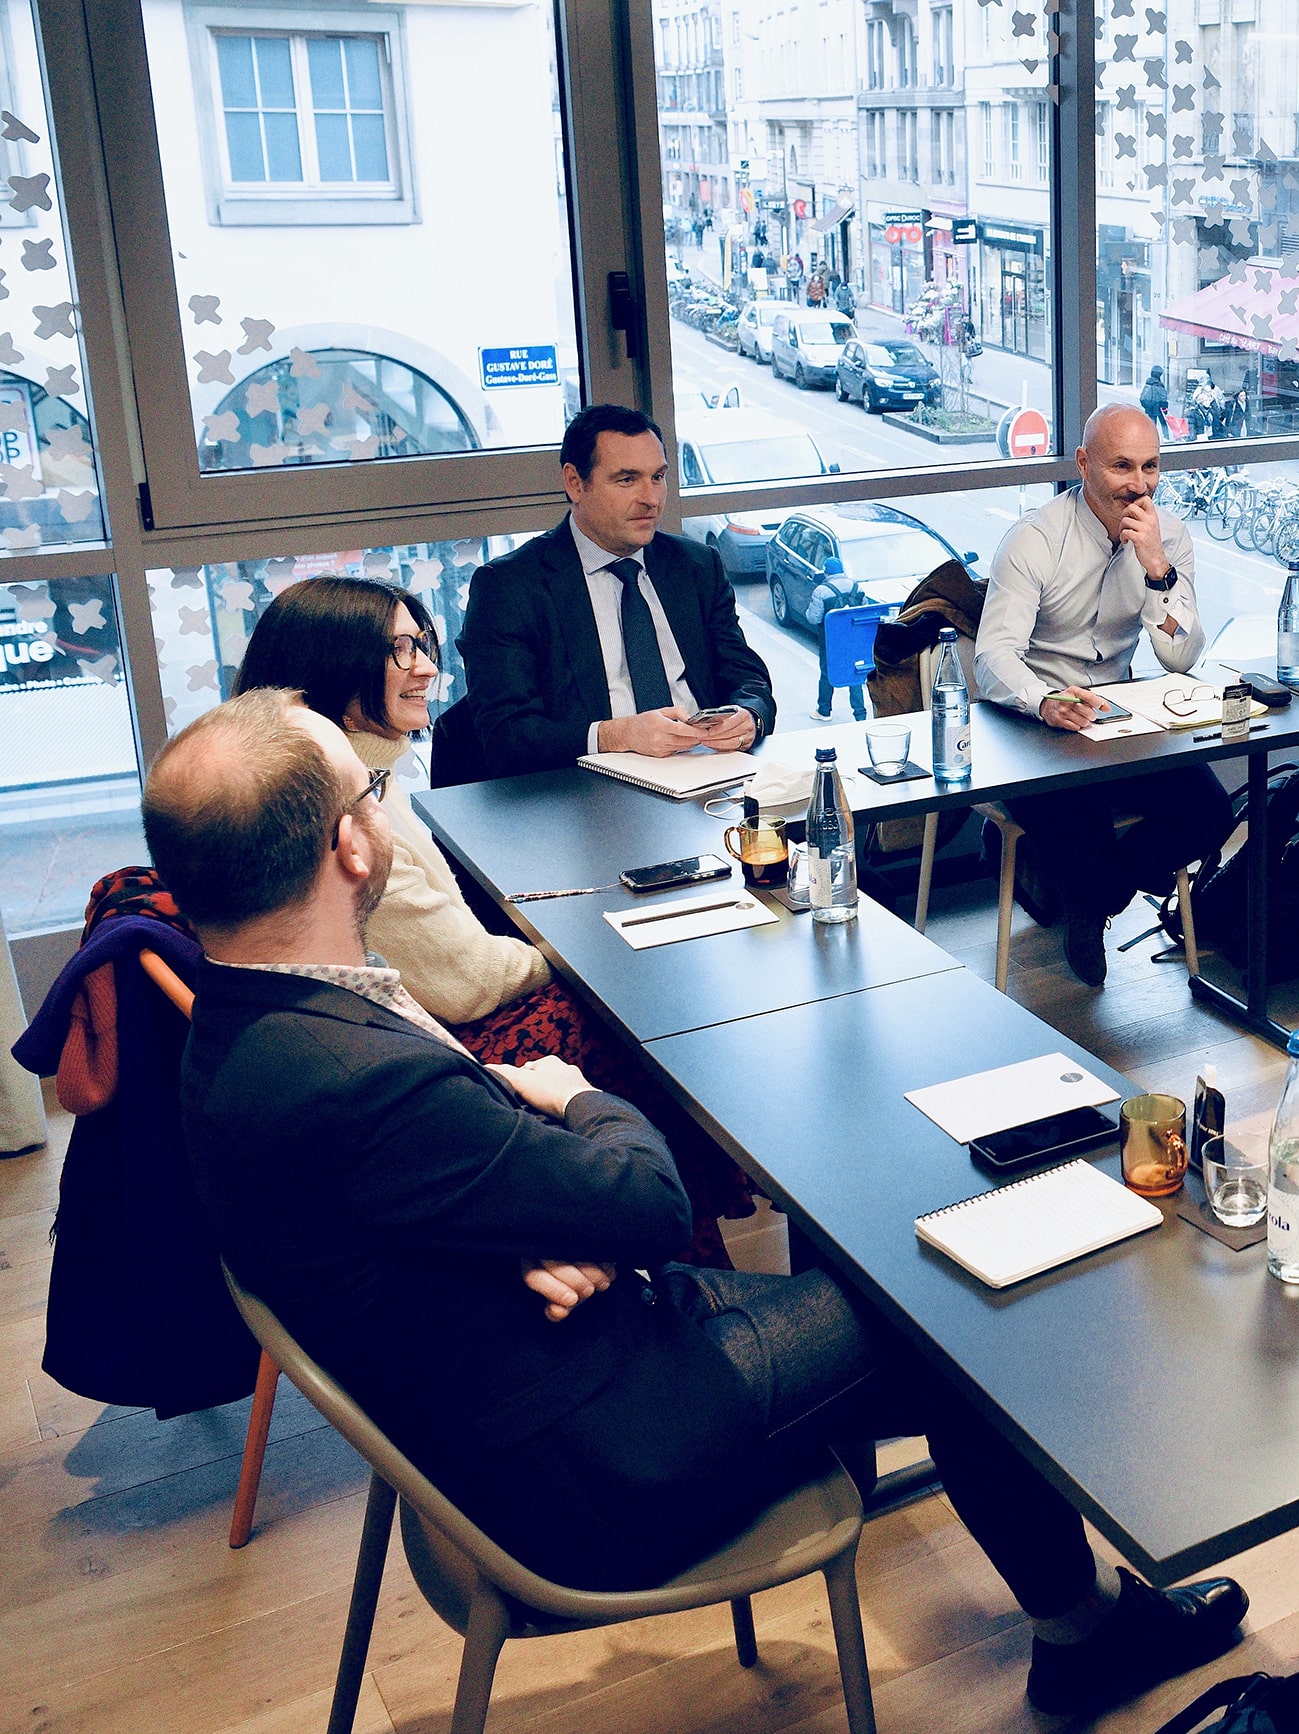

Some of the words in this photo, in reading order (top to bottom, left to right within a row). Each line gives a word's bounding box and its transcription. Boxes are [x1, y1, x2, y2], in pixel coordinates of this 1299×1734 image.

[510, 349, 528, 360] RUE
[486, 361, 527, 373] GUSTAVE
[528, 357, 553, 370] DORÉ
